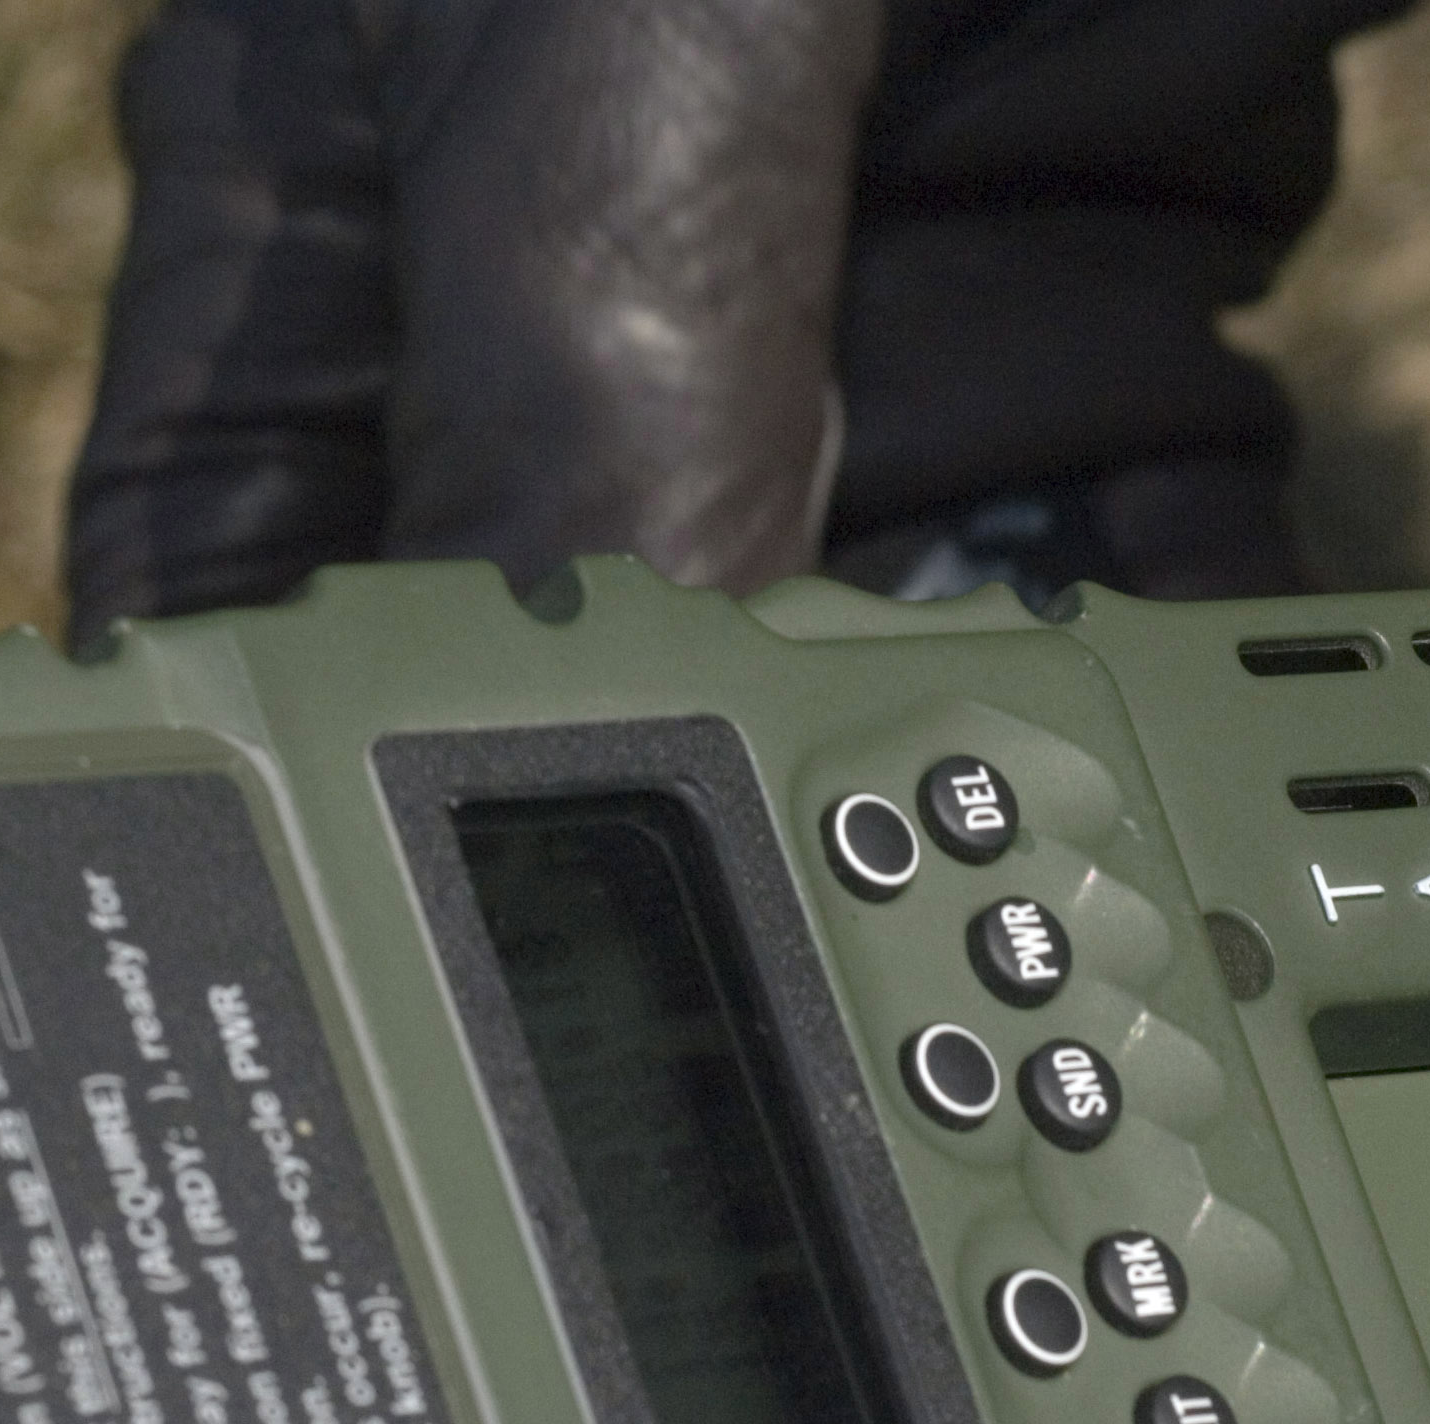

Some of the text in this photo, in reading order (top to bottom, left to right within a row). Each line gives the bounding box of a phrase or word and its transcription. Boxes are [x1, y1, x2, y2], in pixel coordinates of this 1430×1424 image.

[951, 766, 1005, 831] DEL
[83, 869, 127, 932] for
[1016, 903, 1059, 980] PWR
[105, 939, 170, 1061] ready
[207, 983, 270, 1082] PWR
[1063, 1048, 1108, 1119] SND
[7, 1165, 61, 1229] up
[80, 1072, 190, 1295] (ACQUIRE)
[249, 1090, 331, 1262] re-cycle
[27, 1232, 85, 1326] side
[200, 1254, 269, 1365] fixed
[1127, 1238, 1175, 1318] MRK
[58, 1329, 113, 1418] this
[162, 1303, 207, 1369] for
[357, 1282, 428, 1417] knob).
